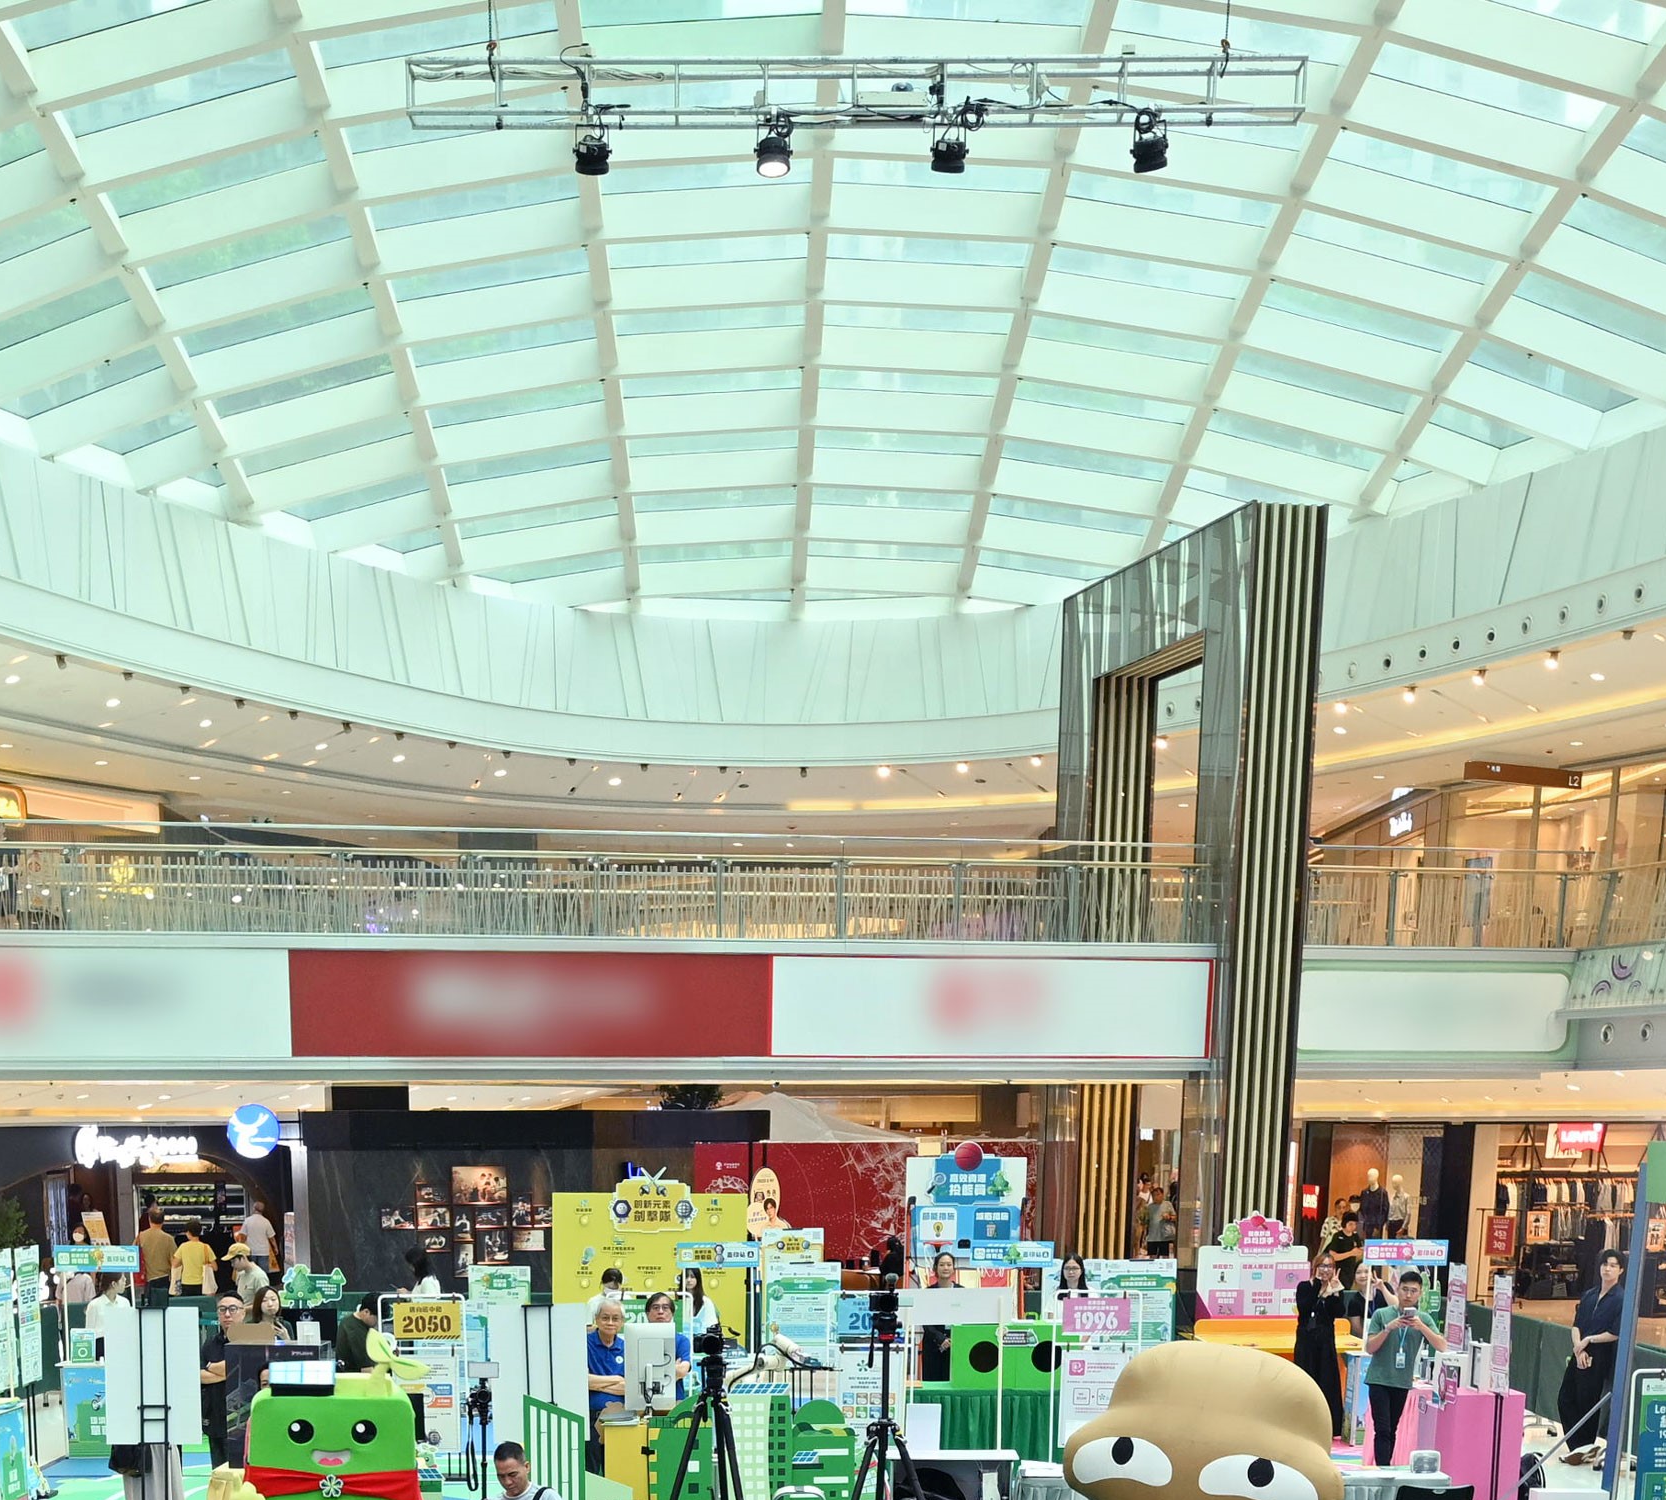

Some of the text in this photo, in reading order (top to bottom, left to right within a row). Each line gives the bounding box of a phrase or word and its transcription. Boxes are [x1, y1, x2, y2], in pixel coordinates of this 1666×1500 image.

[1568, 774, 1580, 788] L2
[402, 1315, 453, 1333] 2050
[1073, 1311, 1119, 1330] 1996
